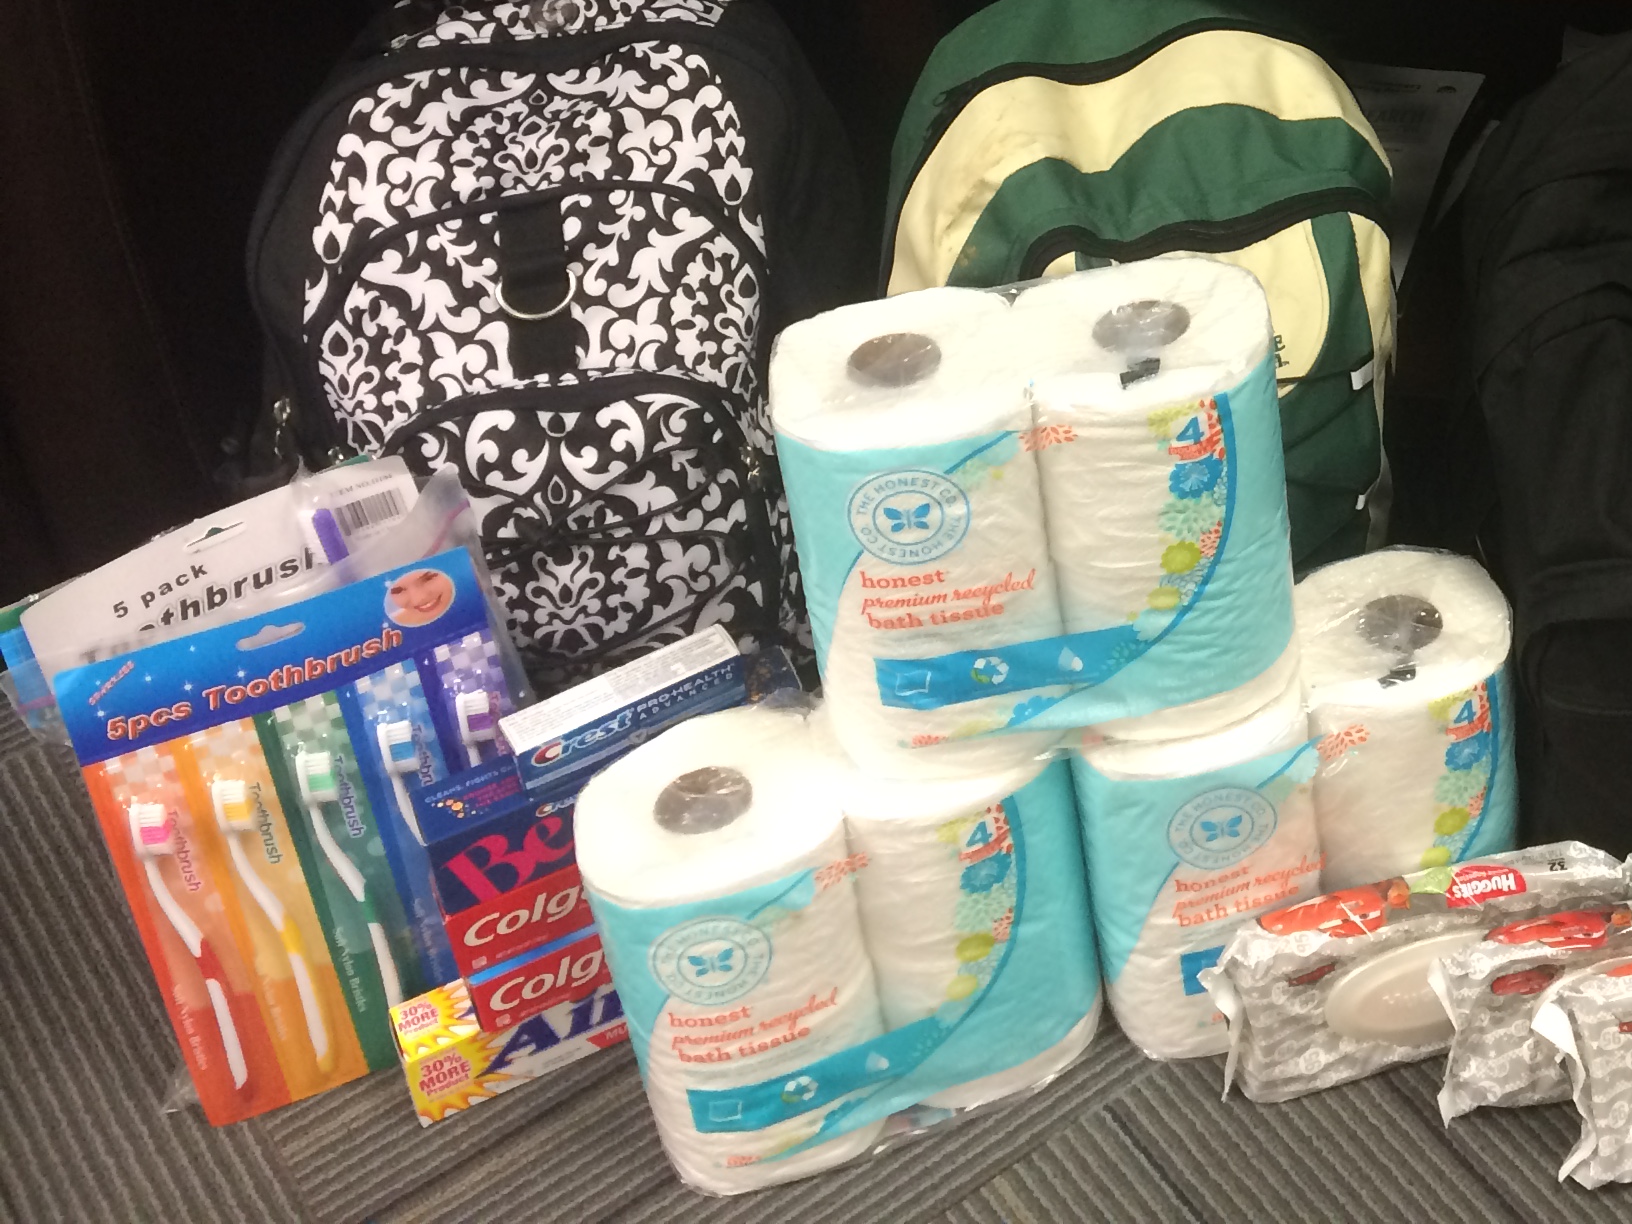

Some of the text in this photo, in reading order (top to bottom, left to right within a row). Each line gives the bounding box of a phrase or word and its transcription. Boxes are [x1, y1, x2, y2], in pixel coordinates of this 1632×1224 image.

[1176, 416, 1205, 444] 4
[856, 476, 940, 516] THE HONEST
[879, 540, 944, 558] HONEST
[112, 562, 210, 619] 5 pack
[136, 546, 326, 633] thbrus
[859, 570, 946, 590] honest
[861, 567, 1037, 616] premium recycled
[866, 603, 1005, 631] bath tissue
[107, 701, 193, 741] 5pcs
[202, 628, 404, 713] Toothbrush
[639, 672, 734, 720] ADVANCED
[1453, 698, 1477, 725] 4
[531, 708, 633, 767] Crest
[334, 755, 367, 839] Toothbrush
[247, 781, 285, 865] Toothbrush
[966, 820, 993, 849] 4
[167, 808, 202, 893] Toothbrush
[1547, 859, 1568, 872] 32
[1172, 851, 1328, 918] premium recycled
[1174, 866, 1251, 893] honest
[1451, 872, 1517, 899] HUGGIES
[463, 885, 588, 947] Colg
[1177, 885, 1299, 927] bath tissue
[489, 948, 604, 1011] Colg
[398, 1008, 440, 1032] MORE
[399, 1000, 433, 1020] 30%
[668, 1005, 752, 1028] honest
[678, 1026, 812, 1064] bath tissue
[418, 1059, 471, 1092] MORE
[420, 1053, 462, 1076] 30%
[426, 1075, 469, 1097] Product
